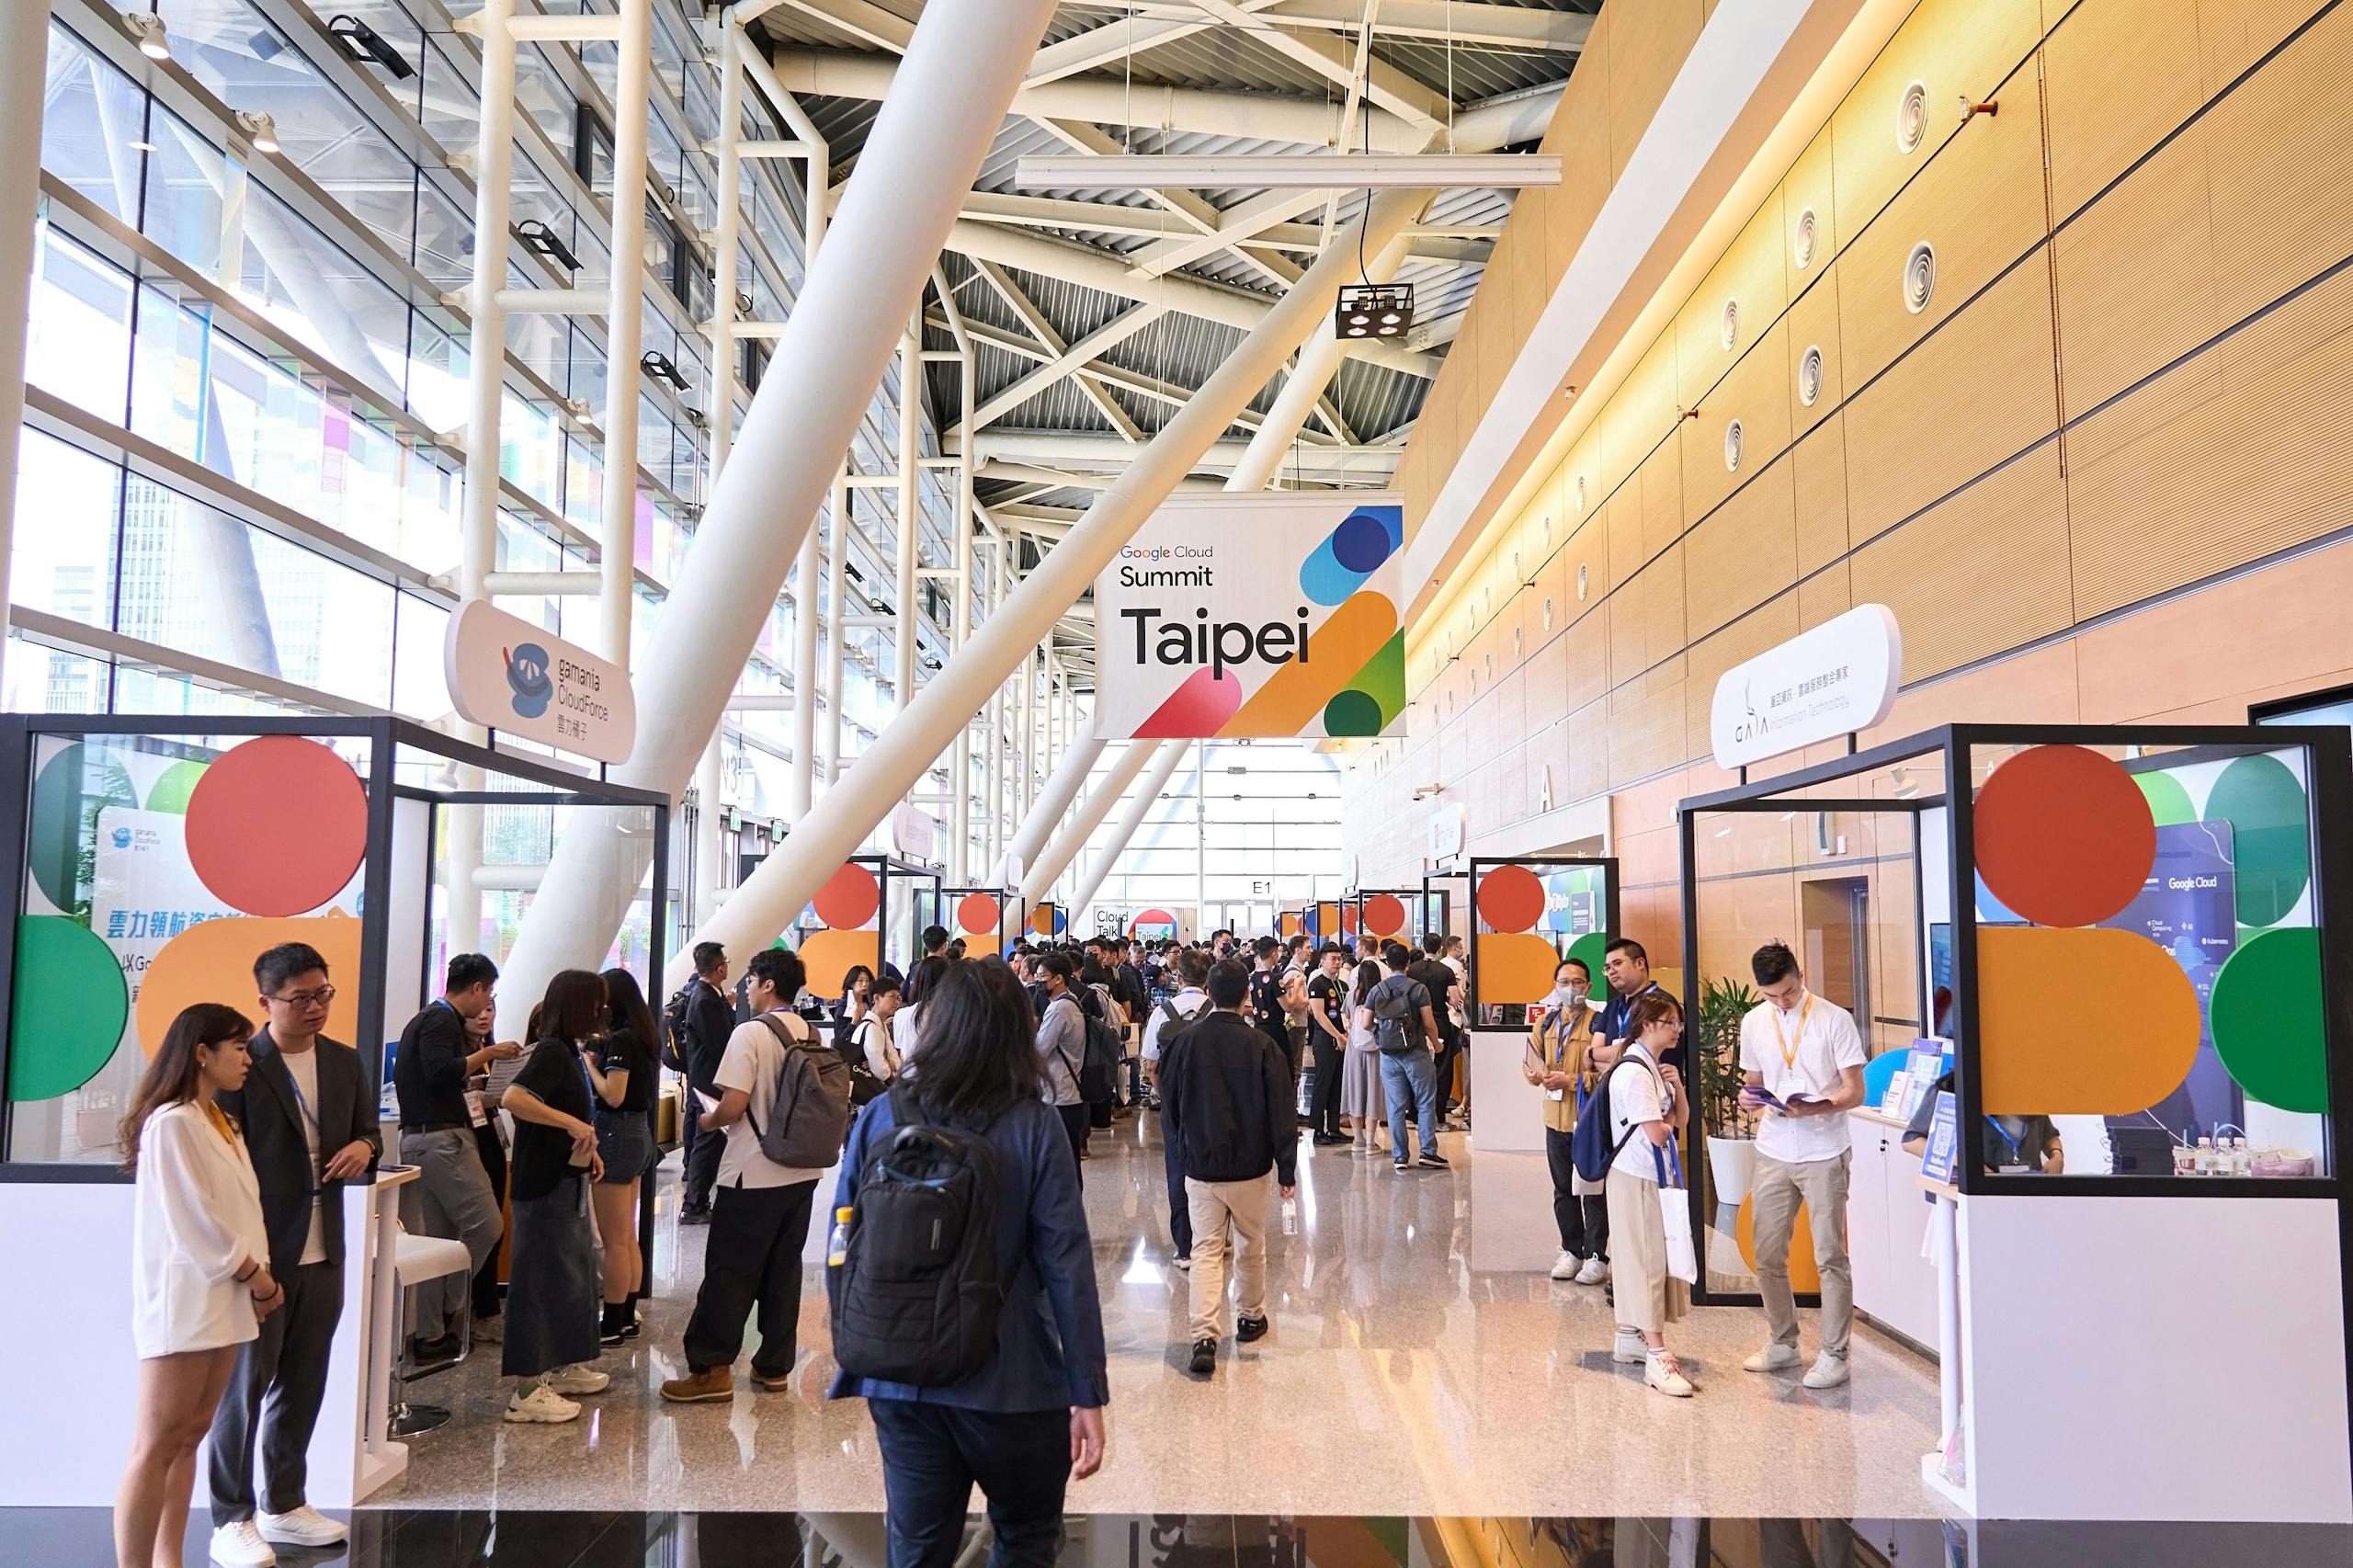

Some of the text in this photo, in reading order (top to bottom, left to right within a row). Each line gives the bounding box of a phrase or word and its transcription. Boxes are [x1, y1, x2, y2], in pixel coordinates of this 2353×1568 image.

[1120, 545, 1213, 561] Google Cloud
[1120, 565, 1213, 587] Summit
[1120, 607, 1309, 680] Taipei
[558, 658, 600, 691] gamania
[557, 683, 609, 722] CloudForce
[1253, 881, 1271, 894] E1
[2168, 877, 2195, 892] Google
[2195, 876, 2218, 889] Cloud
[1137, 931, 1162, 941] Taipei
